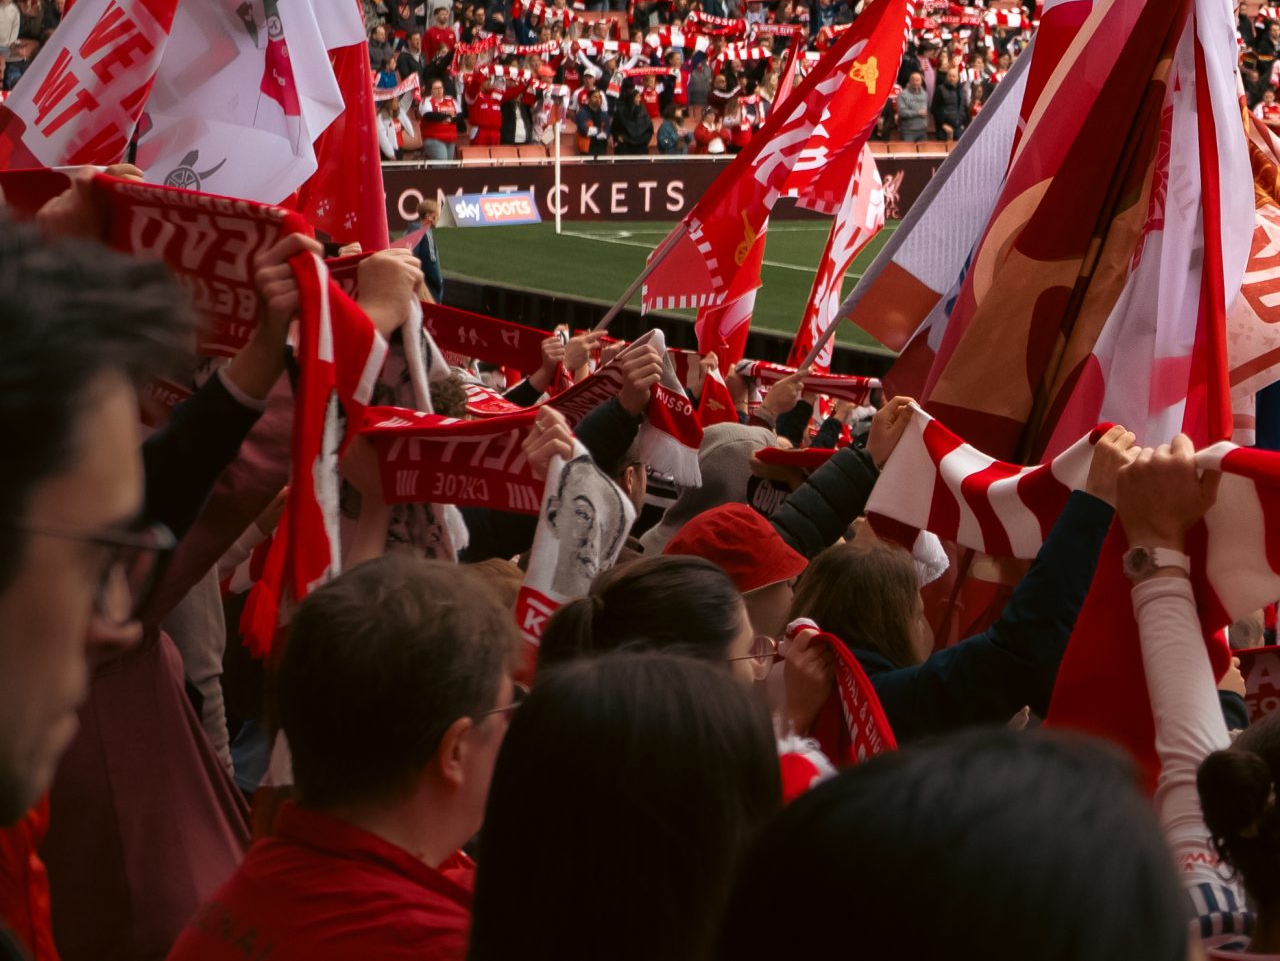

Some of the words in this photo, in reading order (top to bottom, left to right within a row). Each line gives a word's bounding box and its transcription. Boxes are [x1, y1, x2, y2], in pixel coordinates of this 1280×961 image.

[455, 199, 480, 222] sky
[484, 196, 533, 217] sports
[655, 385, 693, 418] RUSSO
[432, 470, 490, 502] CHLOE
